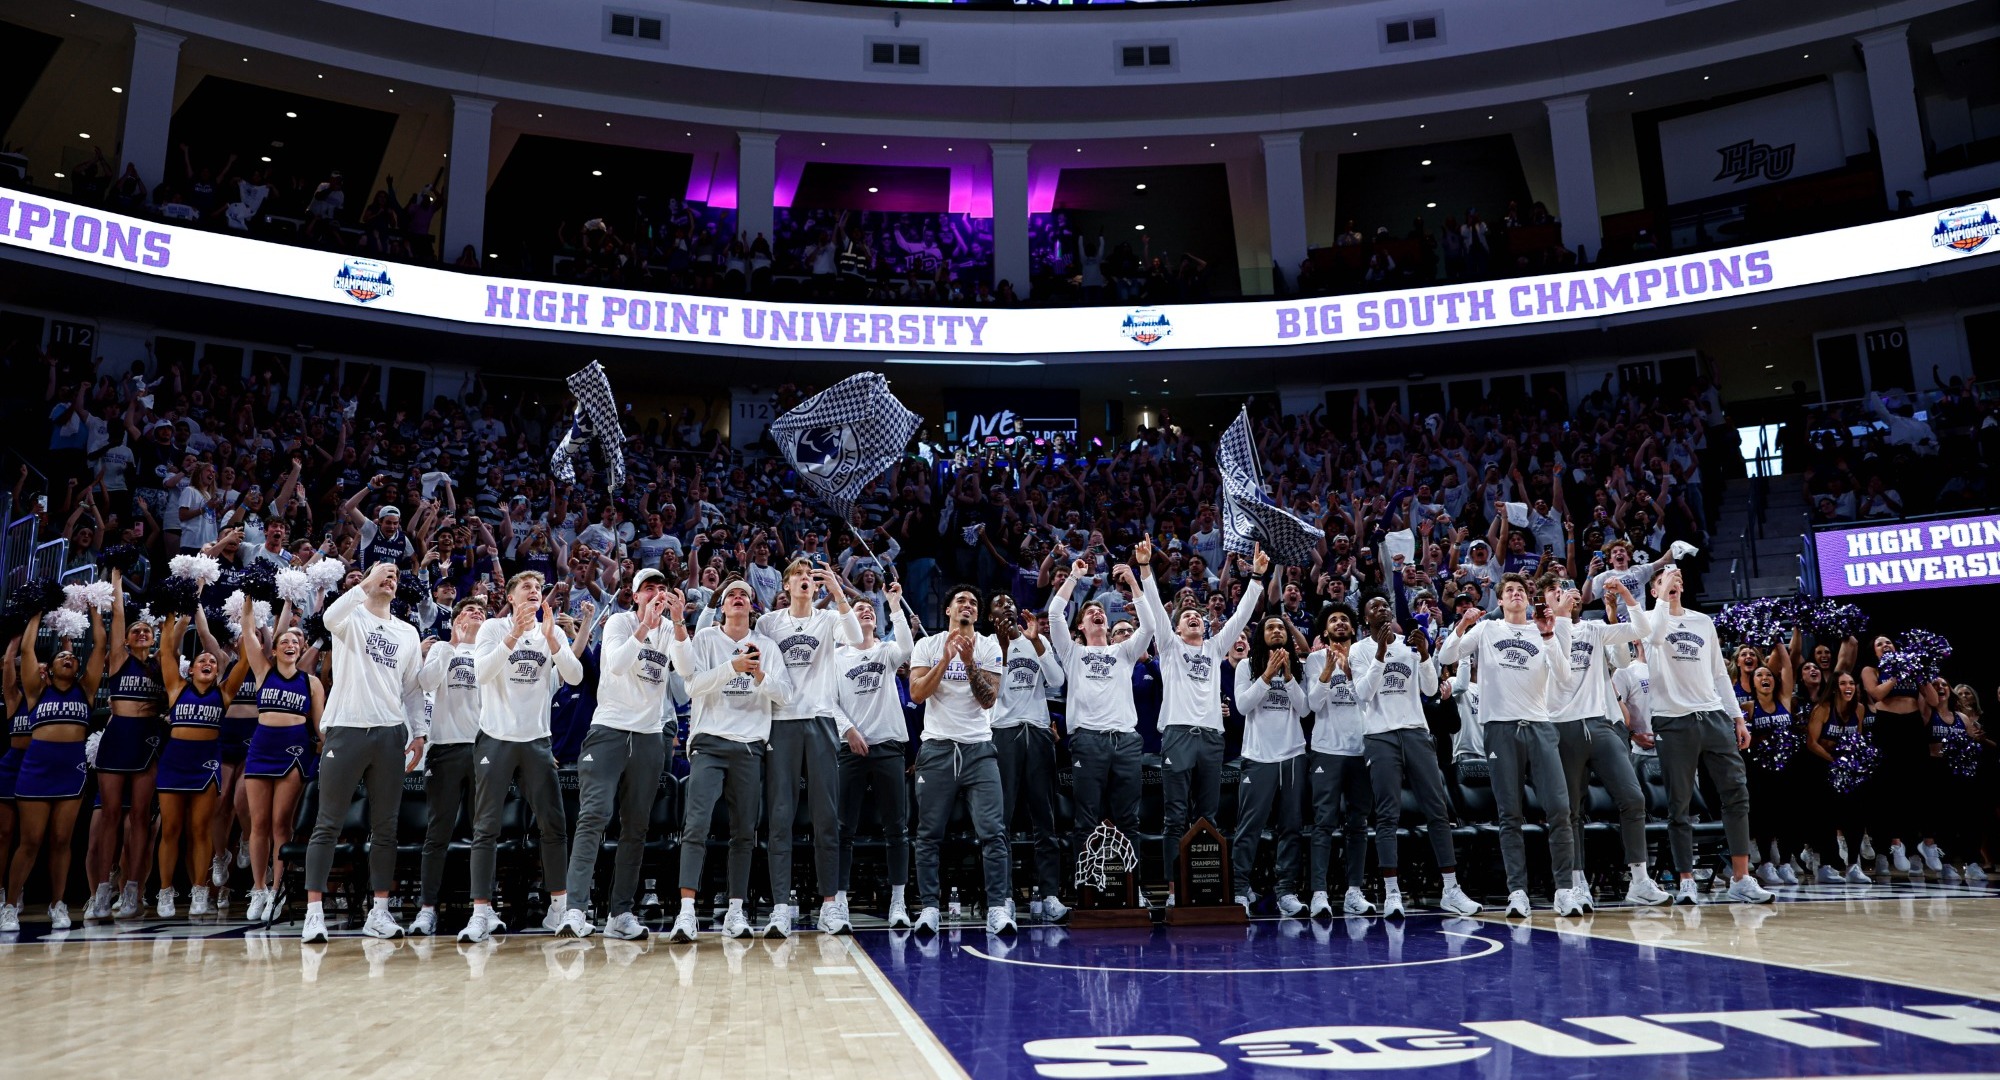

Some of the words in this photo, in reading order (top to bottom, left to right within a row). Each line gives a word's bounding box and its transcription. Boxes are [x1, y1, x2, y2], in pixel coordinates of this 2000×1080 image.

[1713, 138, 1795, 183] HPU
[334, 276, 395, 297] CHAMPIONSHIPS
[1276, 304, 1343, 338] BIG
[1357, 289, 1497, 331] SOUTH
[1509, 250, 1774, 317] CHAMPIONS
[485, 285, 589, 325] HIGH
[602, 296, 728, 336] POINT
[742, 308, 988, 346] UNIVERSITY
[56, 324, 92, 347] 112
[1867, 331, 1904, 352] 110
[1623, 365, 1651, 382] 111
[740, 403, 768, 419] 112
[373, 544, 387, 555] HIGH
[1846, 527, 1924, 557] HIGH
[366, 632, 399, 658] HPU
[1676, 642, 1699, 657] HPU
[787, 647, 812, 662] HPU
[1503, 649, 1529, 665] HPU
[453, 668, 476, 685] HPU
[515, 662, 538, 678] HPU
[120, 676, 140, 688] HIGH
[857, 675, 880, 689] HPU
[1383, 675, 1406, 689] HPU
[261, 688, 280, 700] HIGH
[280, 690, 307, 707] POINT
[1267, 692, 1289, 706] HPU
[37, 701, 60, 714] HIGH
[62, 701, 88, 714] POINT
[175, 703, 195, 716] HIGH
[197, 705, 223, 719] POINT
[13, 715, 31, 728] HIG
[1755, 715, 1770, 726] HIGH
[1771, 713, 1791, 723] POINT
[1828, 724, 1843, 734] HIGH
[1932, 725, 1948, 735] HIGH
[1459, 770, 1490, 778] UNIVERS
[1190, 844, 1219, 852] SOUTH
